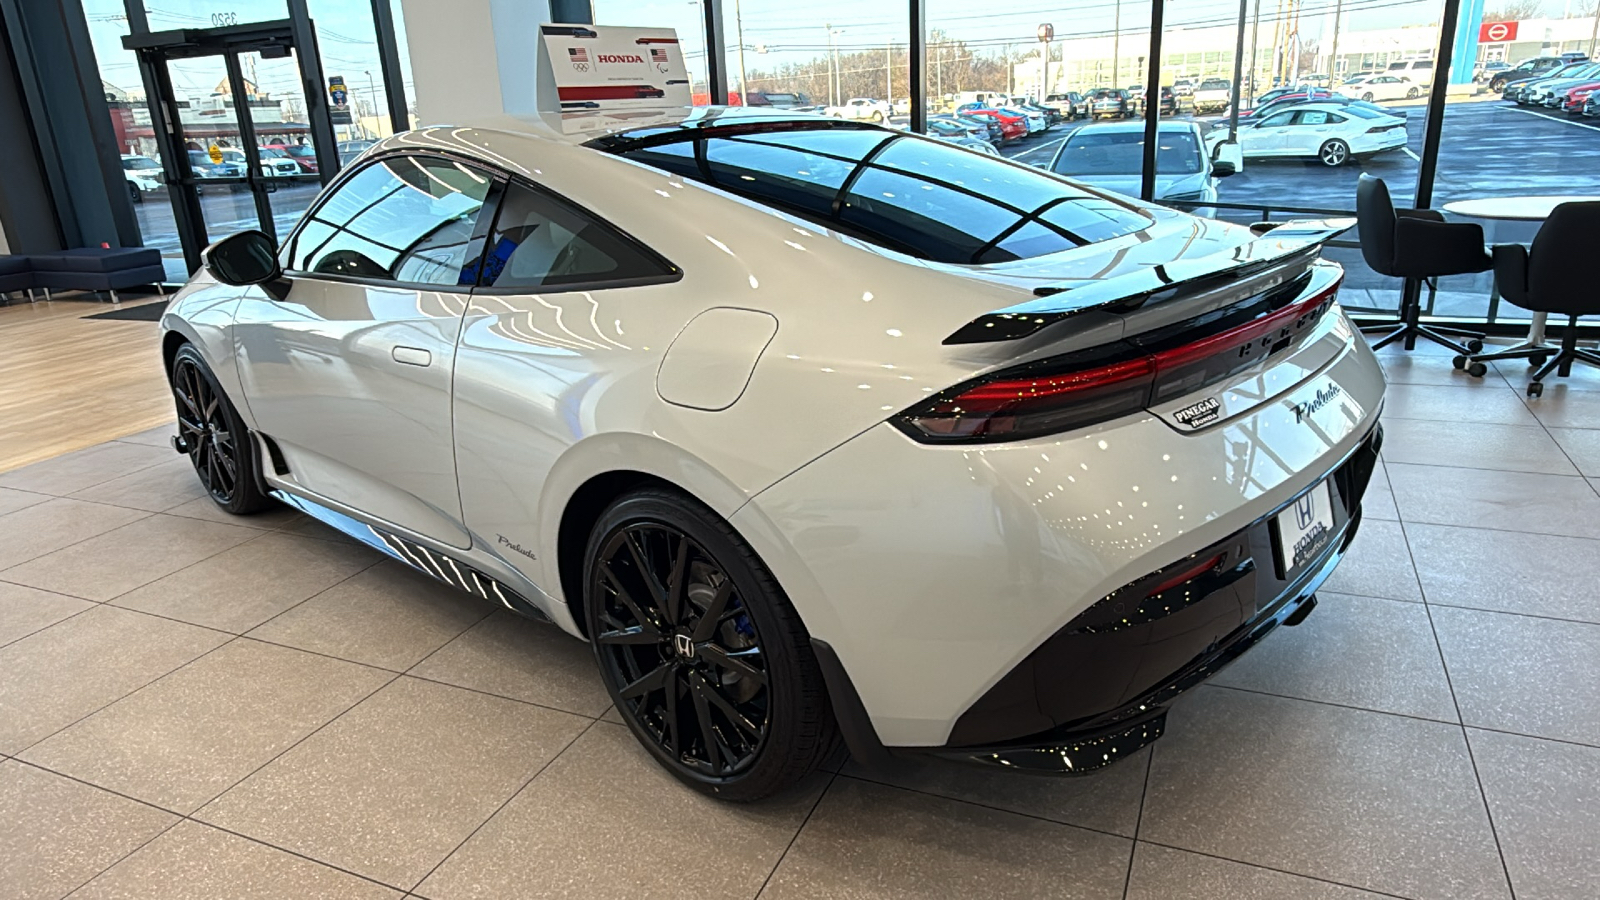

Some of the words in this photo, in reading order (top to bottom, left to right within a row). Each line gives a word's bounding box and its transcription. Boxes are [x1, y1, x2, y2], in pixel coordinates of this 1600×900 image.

[597, 54, 645, 64] HONDA
[1174, 397, 1220, 423] PINEGAR
[1288, 382, 1341, 425] Prelude
[495, 533, 537, 560] Prelude
[1293, 520, 1327, 555] HONDA
